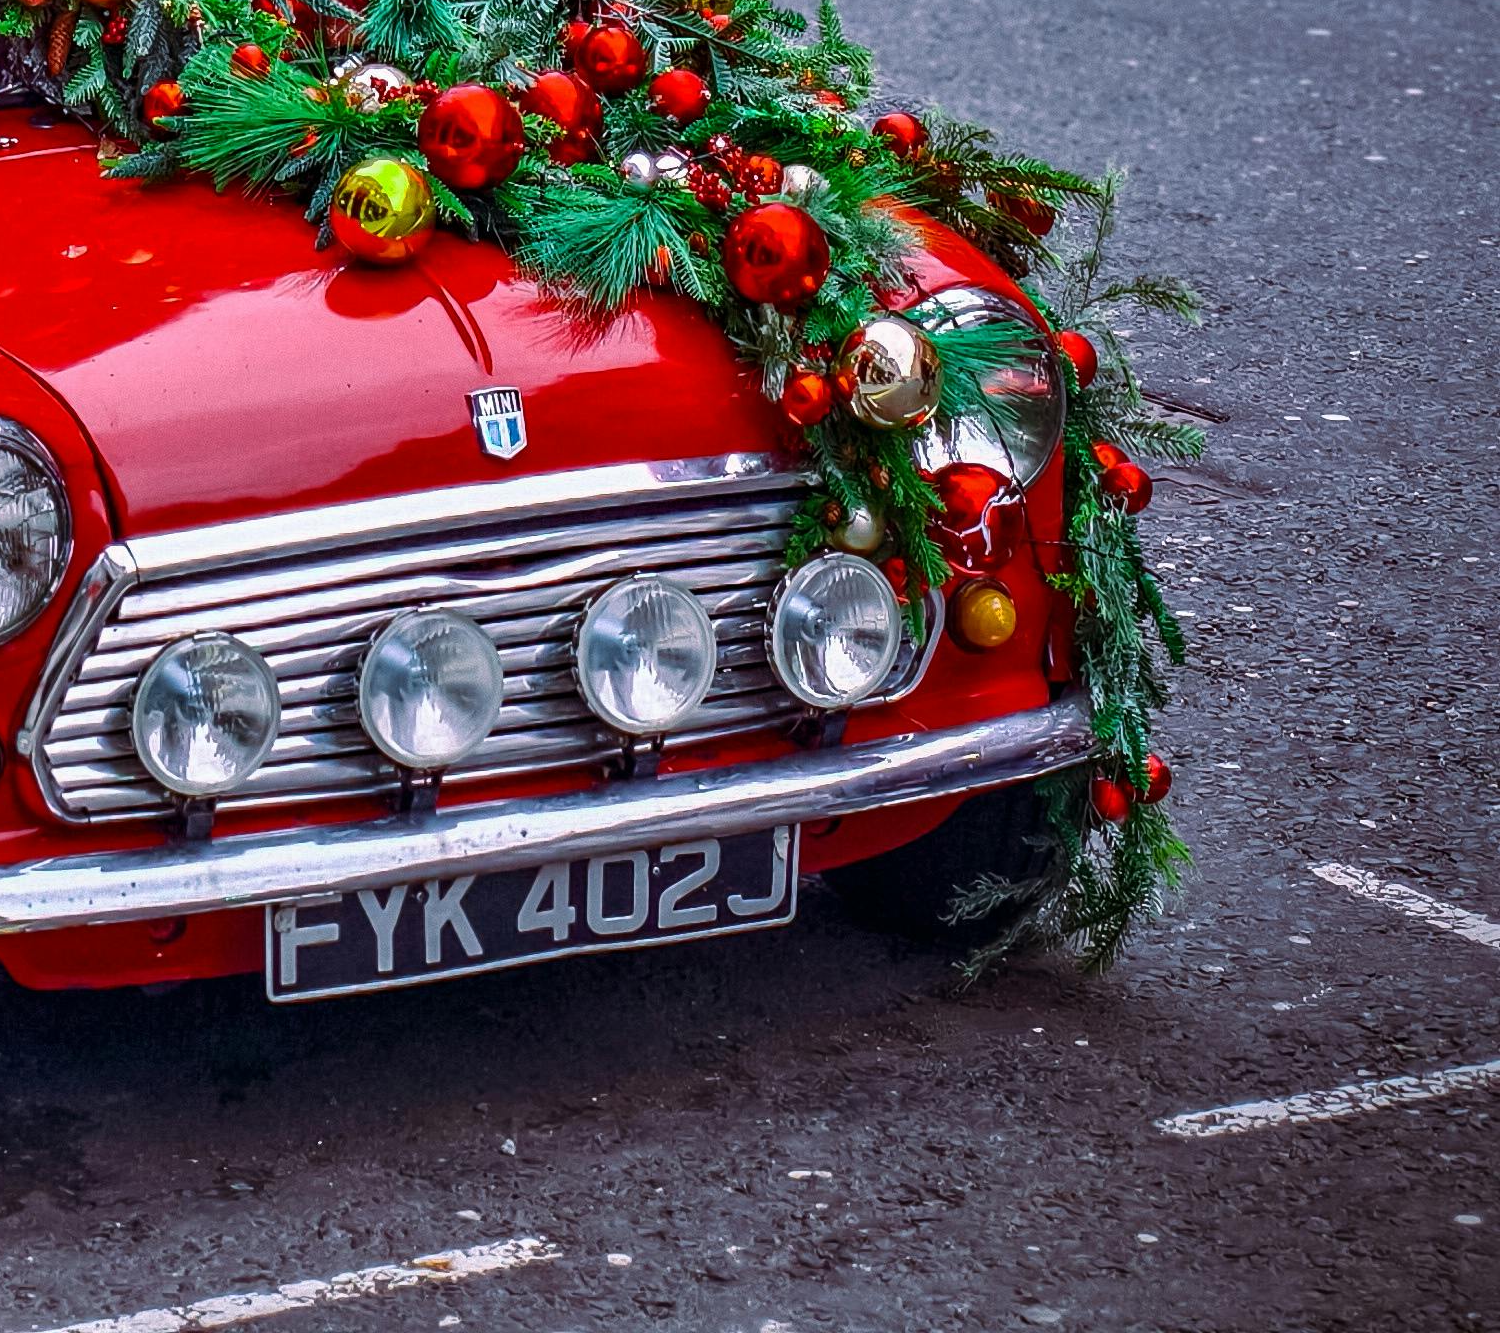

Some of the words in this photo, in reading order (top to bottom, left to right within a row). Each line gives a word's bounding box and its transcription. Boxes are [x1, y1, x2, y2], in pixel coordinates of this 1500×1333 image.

[478, 391, 518, 417] MINI
[278, 873, 484, 987] FYK
[516, 825, 791, 942] 402J
